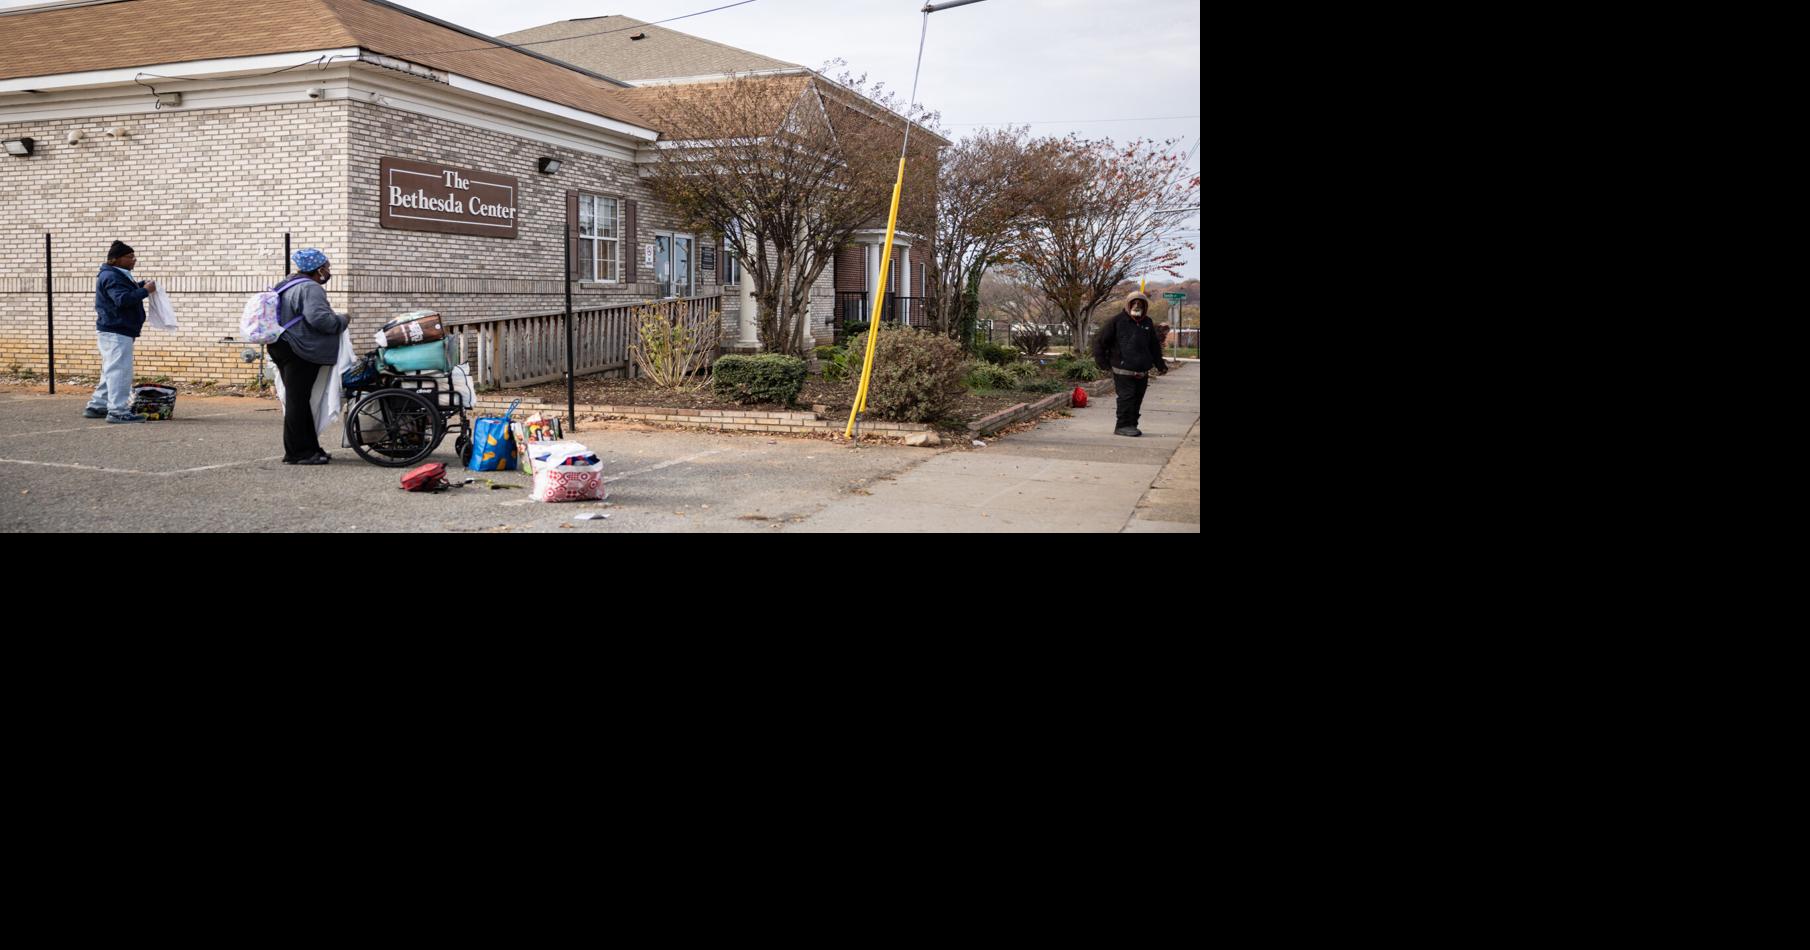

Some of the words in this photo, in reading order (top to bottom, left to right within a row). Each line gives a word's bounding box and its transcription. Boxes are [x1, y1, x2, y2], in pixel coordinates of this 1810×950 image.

[442, 170, 469, 190] The
[389, 185, 463, 214] Bethesda
[469, 196, 516, 219] Center
